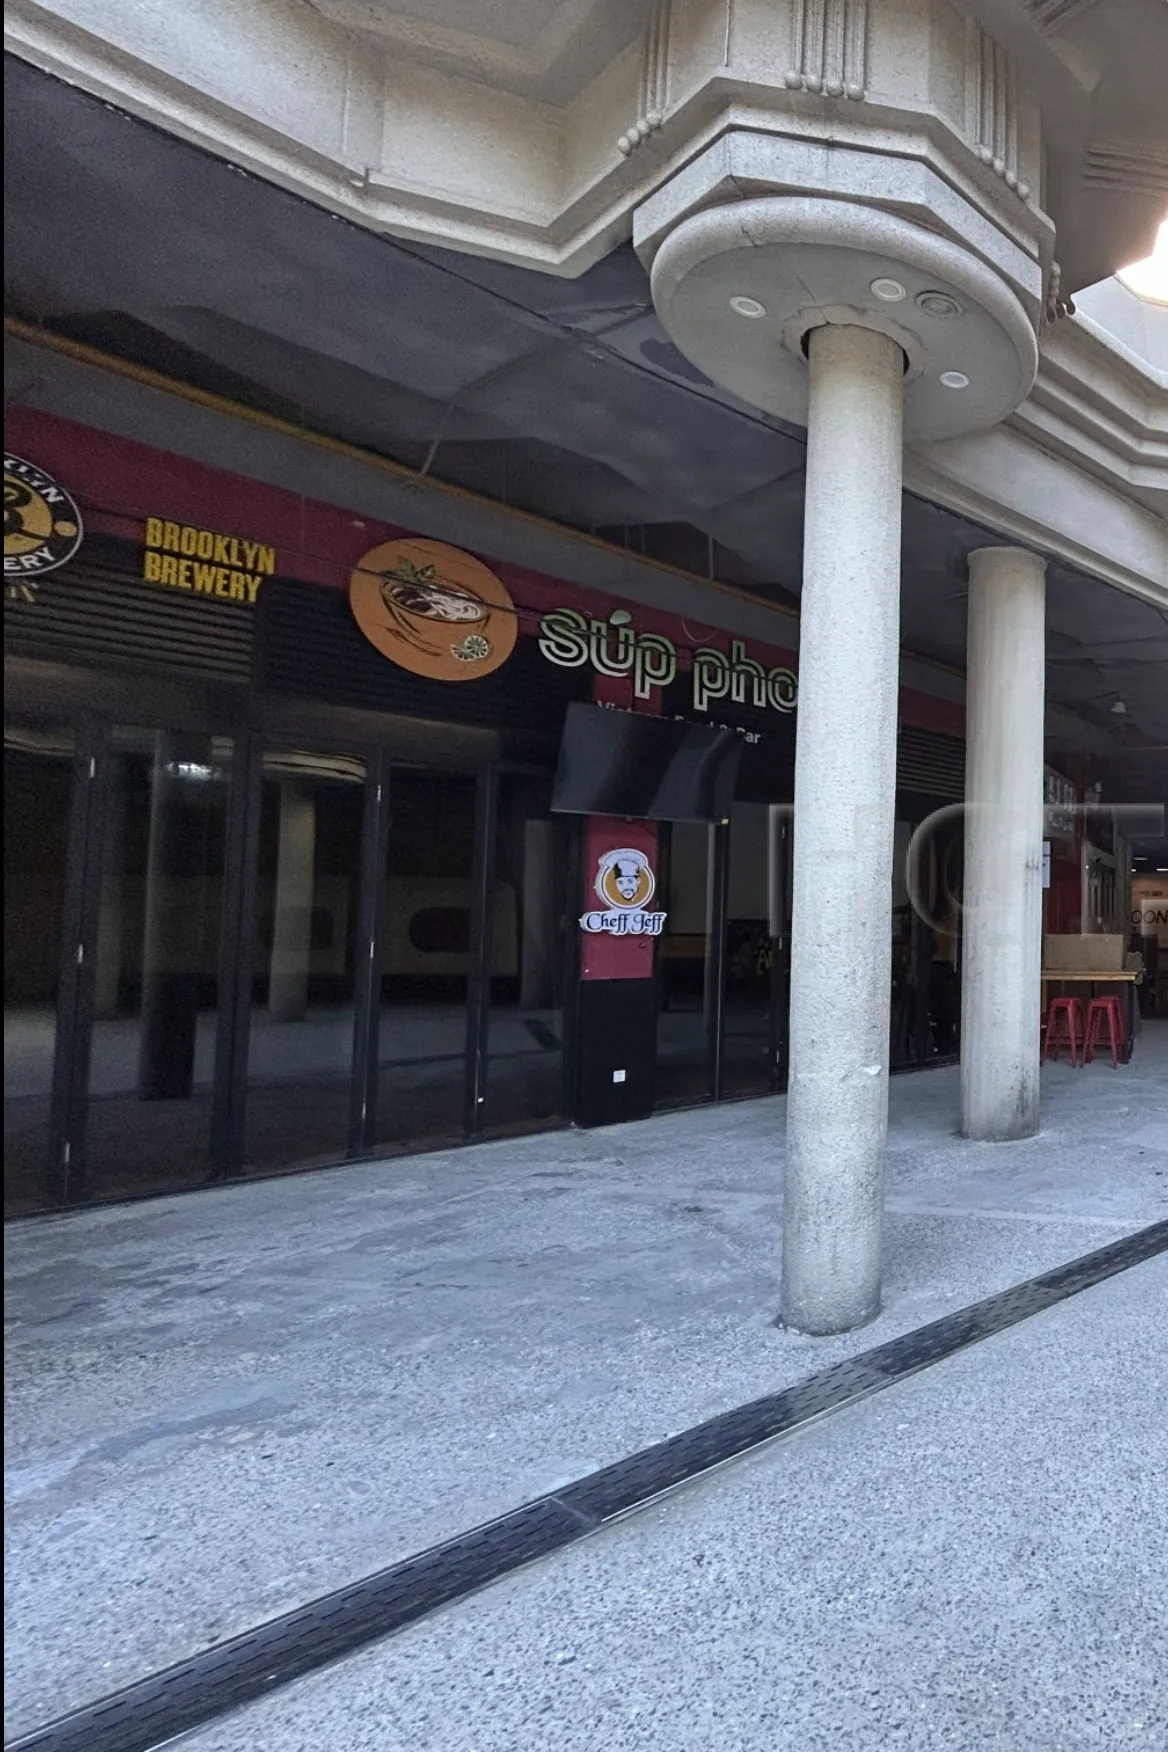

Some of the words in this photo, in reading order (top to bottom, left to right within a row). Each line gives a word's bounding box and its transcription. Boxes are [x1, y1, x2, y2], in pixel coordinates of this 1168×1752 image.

[146, 517, 275, 575] BROOKLYN
[144, 552, 263, 603] BREWERY
[586, 913, 631, 933] Cheff
